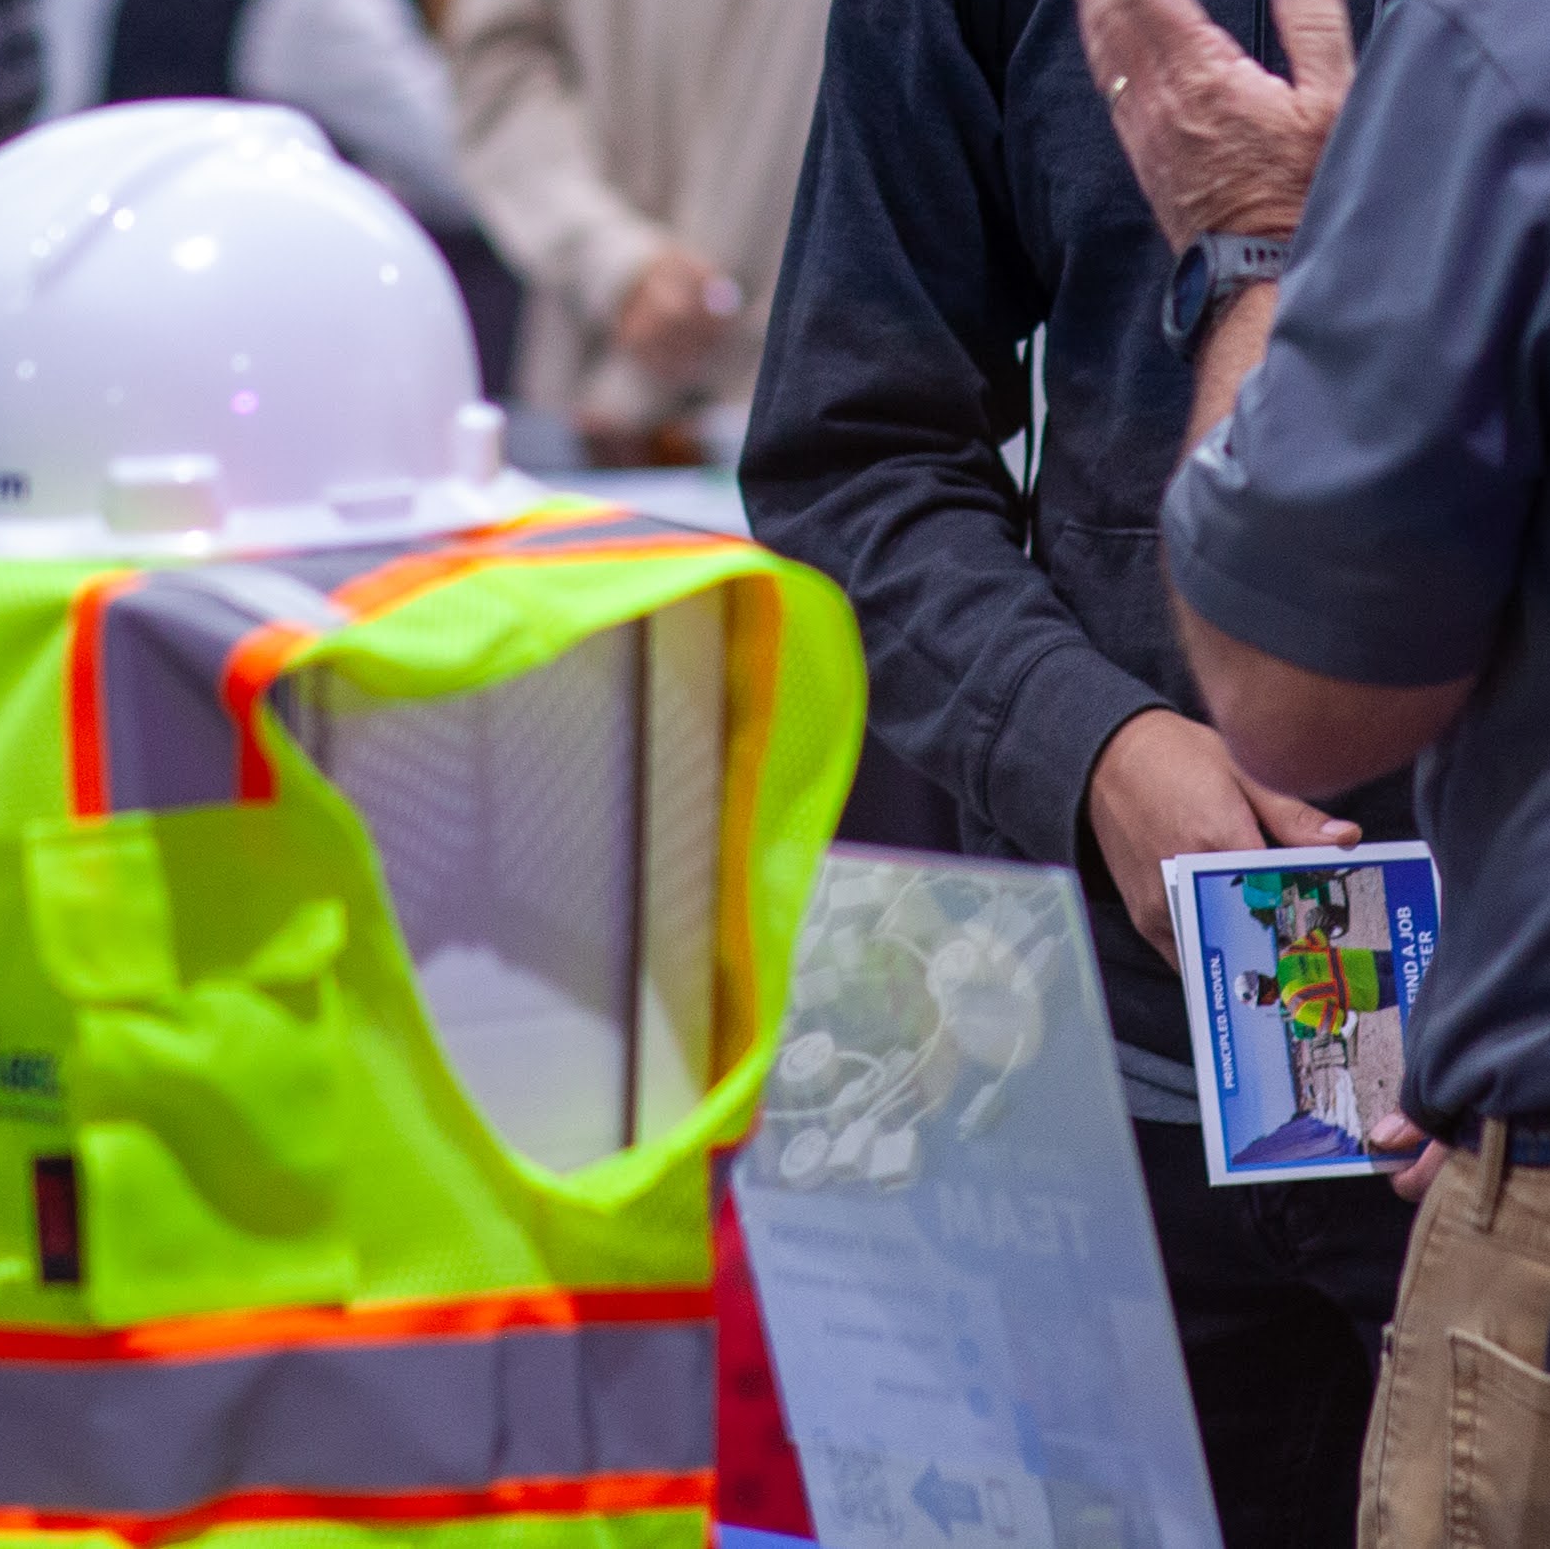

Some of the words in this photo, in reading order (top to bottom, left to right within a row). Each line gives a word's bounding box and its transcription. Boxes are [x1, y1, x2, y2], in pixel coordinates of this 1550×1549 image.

[1396, 905, 1415, 943] JOB
[1401, 943, 1418, 959] A
[1207, 952, 1225, 1010] PROVEN.
[1215, 1011, 1236, 1090] PRINCIPLED.
